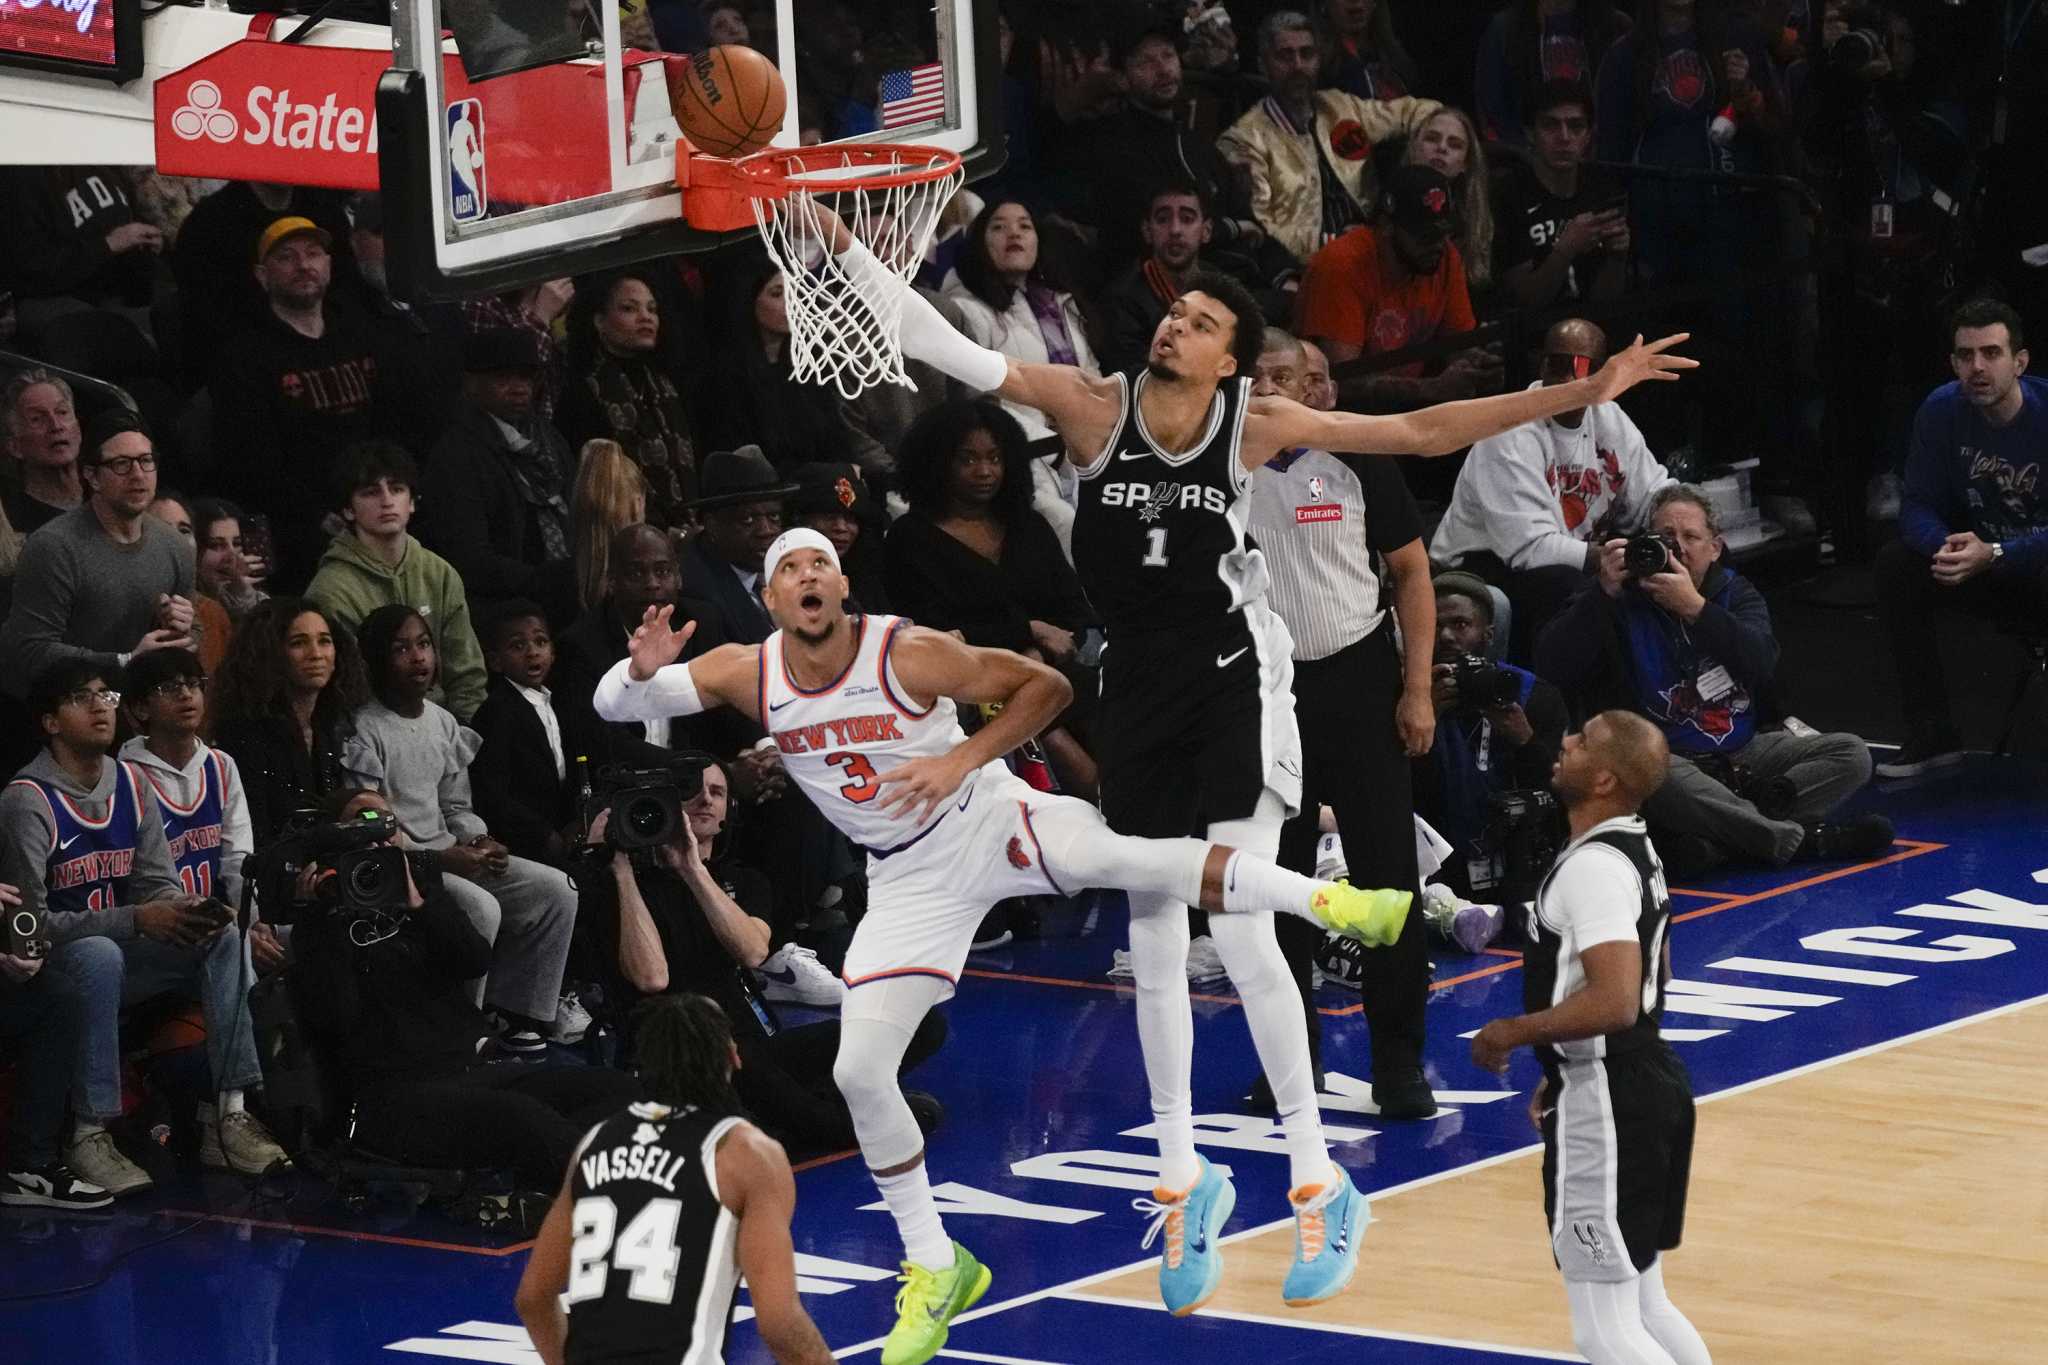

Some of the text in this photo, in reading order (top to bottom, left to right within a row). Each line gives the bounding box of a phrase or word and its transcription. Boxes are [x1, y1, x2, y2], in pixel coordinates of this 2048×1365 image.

[243, 85, 365, 154] State
[455, 193, 474, 215] NBA
[1101, 481, 1226, 524] SPURS
[1296, 508, 1342, 521] Emirates
[1142, 527, 1169, 567] 1
[774, 713, 904, 754] NEW YORK
[824, 751, 881, 804] 3
[53, 848, 136, 889] NEW YOR
[179, 860, 213, 897] 11
[581, 1144, 686, 1193] VASSELL
[568, 1196, 684, 1305] 24
